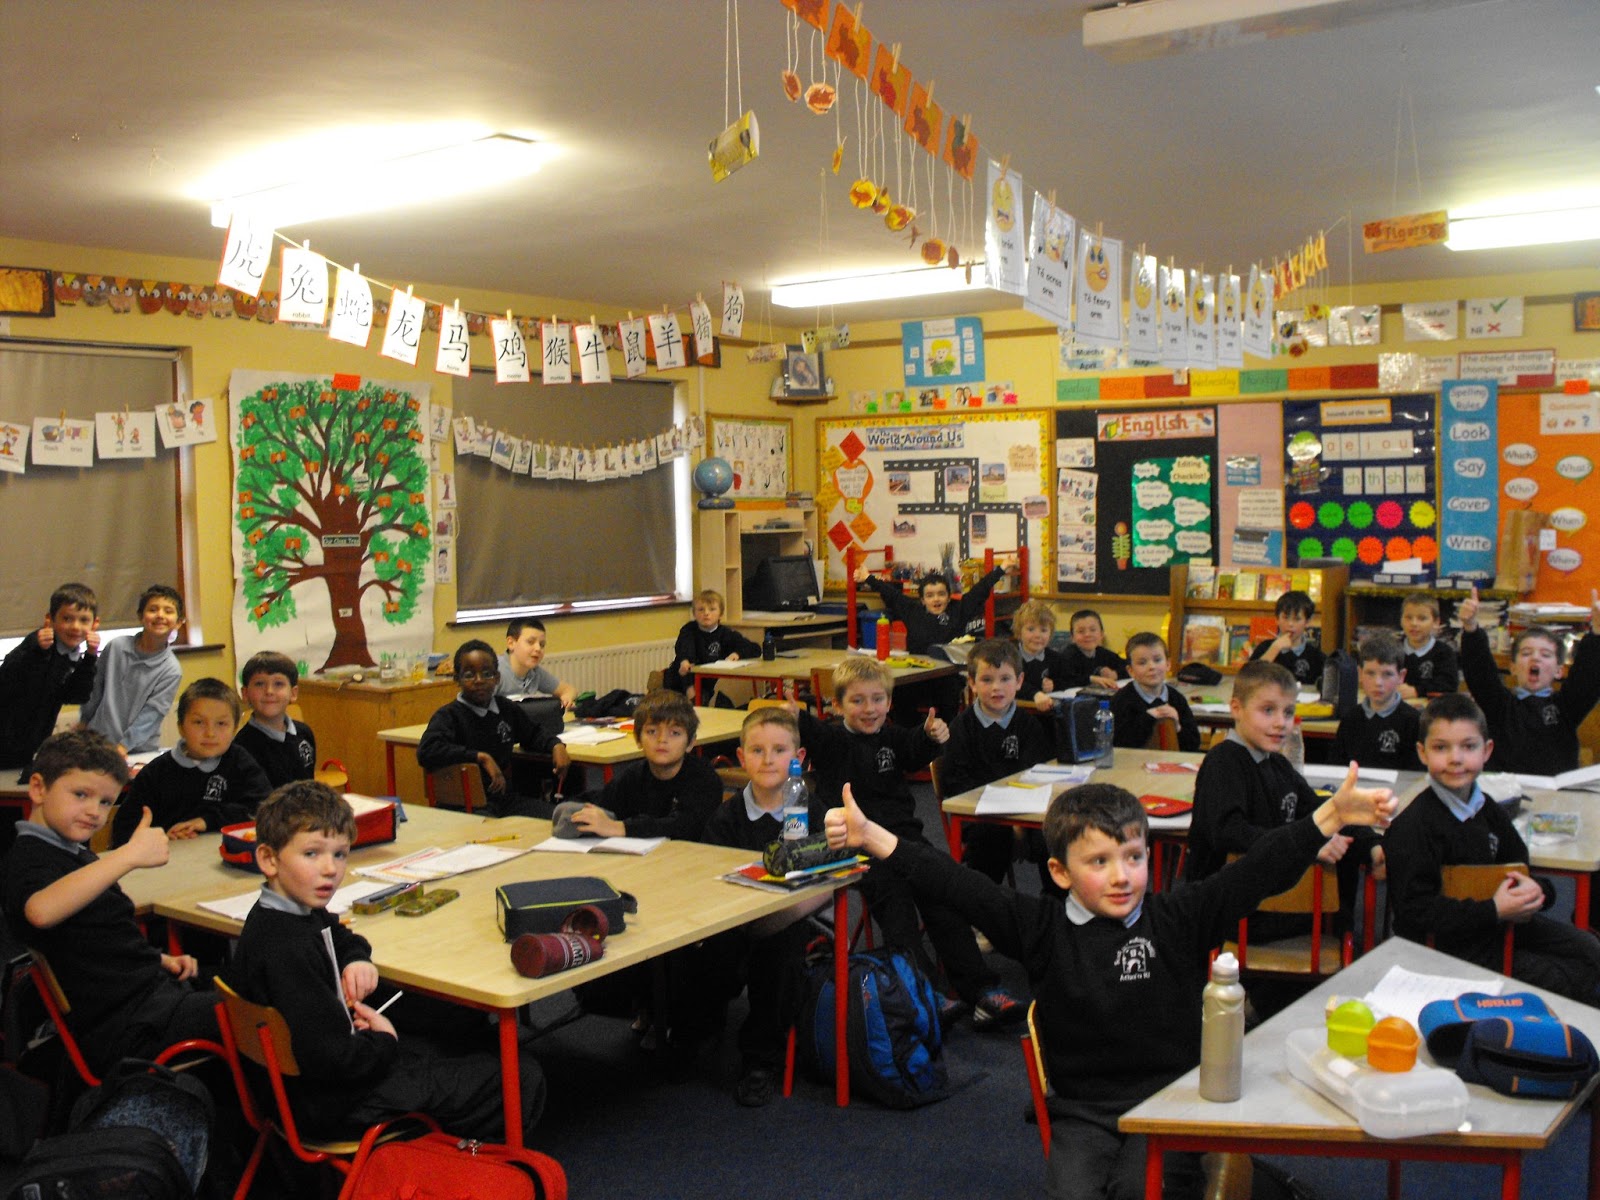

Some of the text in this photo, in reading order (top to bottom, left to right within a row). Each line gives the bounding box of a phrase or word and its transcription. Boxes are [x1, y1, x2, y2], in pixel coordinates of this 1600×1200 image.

[284, 264, 323, 304] 兔
[724, 295, 743, 324] 狗
[390, 309, 418, 347] 龙
[442, 324, 469, 363] 马
[656, 322, 682, 359] 羊
[498, 331, 527, 368] 鸡
[544, 336, 571, 367] 猴
[581, 333, 605, 373] 牛
[625, 331, 646, 365] 鼠
[868, 431, 962, 445] World Around Us
[1122, 413, 1189, 438] English
[1452, 425, 1488, 440] Look
[1457, 460, 1484, 476] Say
[1449, 497, 1489, 510] Cover
[1449, 536, 1490, 550] Write
